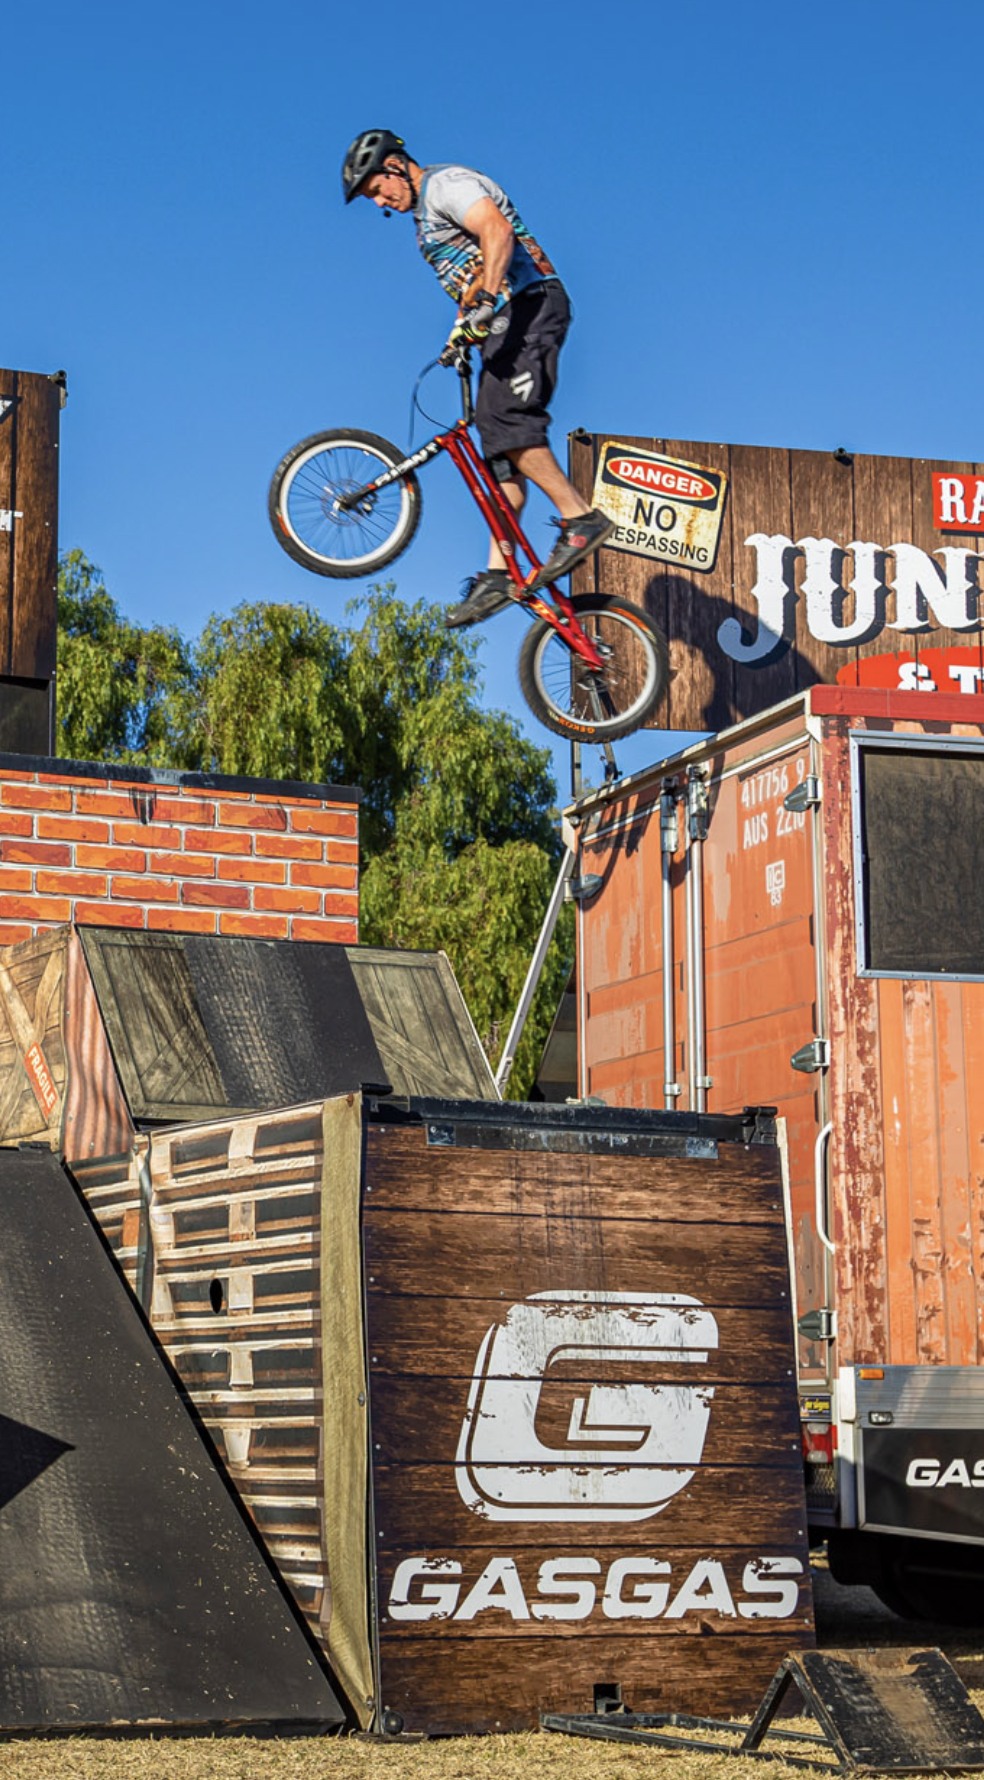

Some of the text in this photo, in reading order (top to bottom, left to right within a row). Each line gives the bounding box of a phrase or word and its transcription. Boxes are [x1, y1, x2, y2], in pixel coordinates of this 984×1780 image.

[618, 460, 704, 497] DANGER
[633, 497, 678, 532] NO
[608, 525, 709, 563] ESPASSING
[717, 533, 984, 663] JUN
[741, 758, 805, 808] 417756 9
[743, 812, 768, 849] AUS
[28, 1046, 56, 1109] FRAGILE
[388, 1556, 804, 1622] GASGAS
